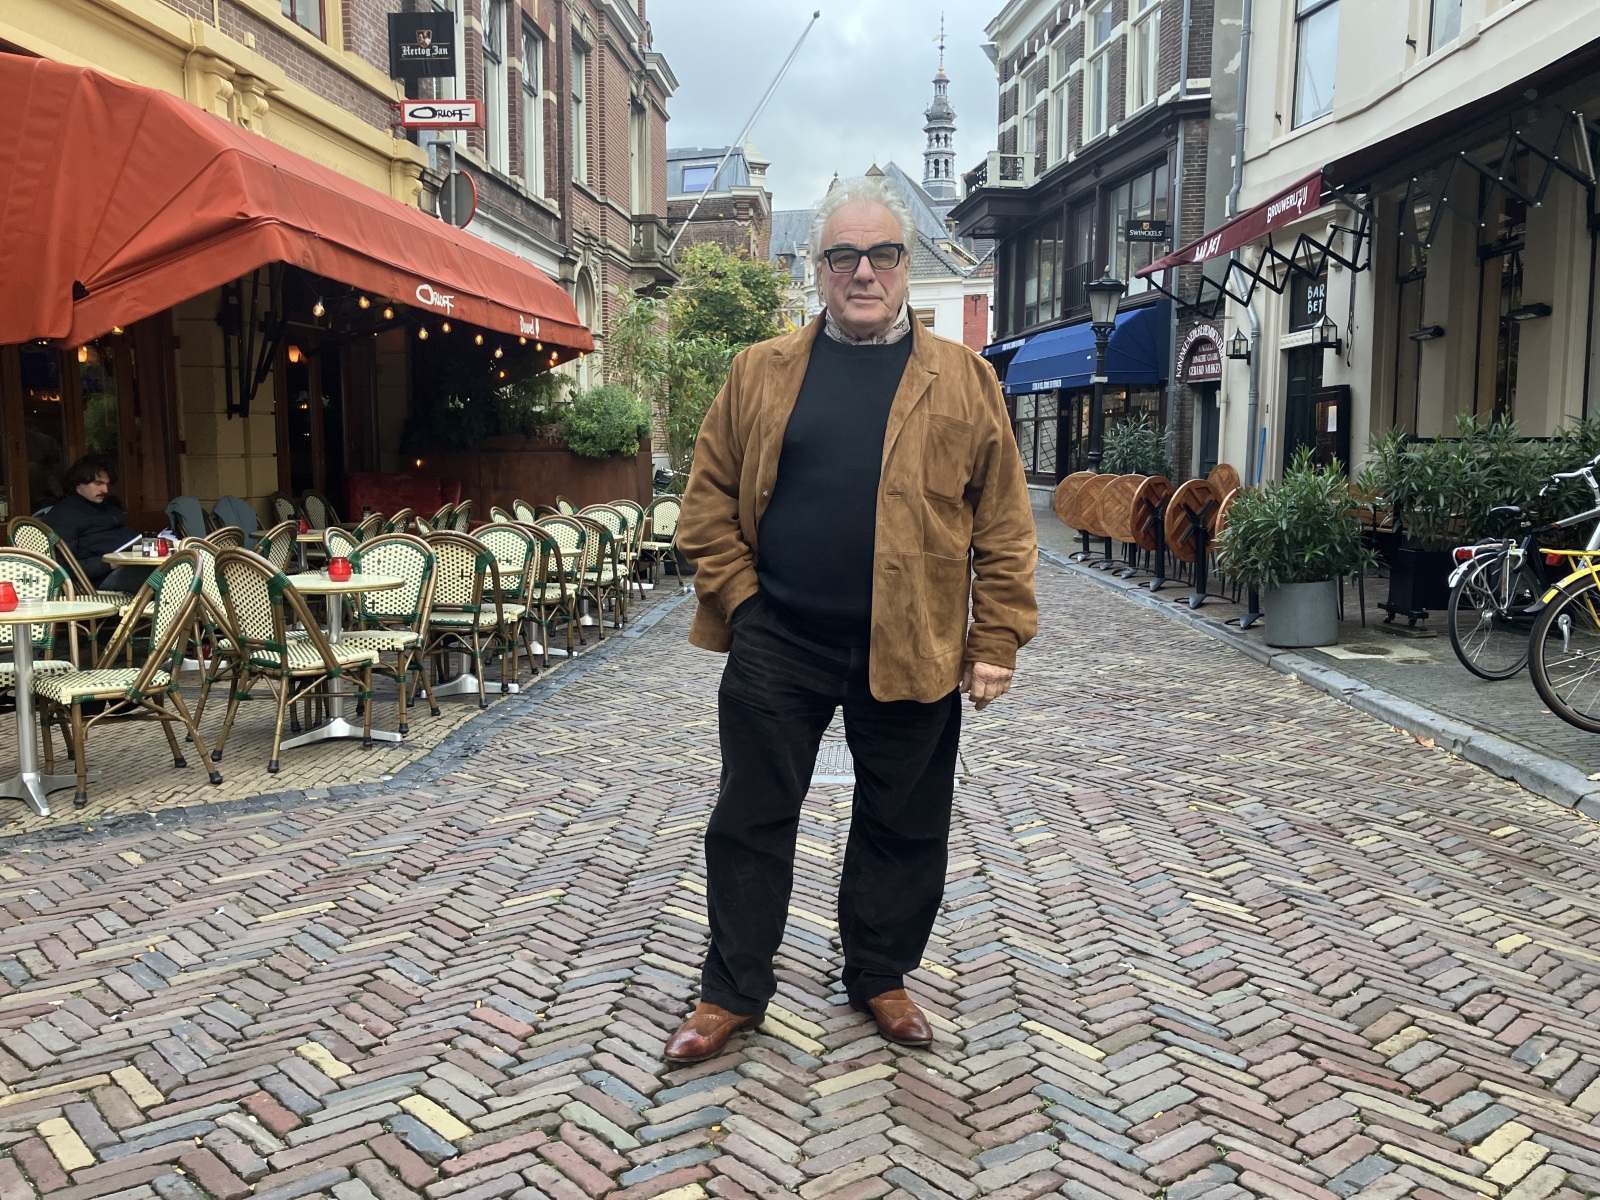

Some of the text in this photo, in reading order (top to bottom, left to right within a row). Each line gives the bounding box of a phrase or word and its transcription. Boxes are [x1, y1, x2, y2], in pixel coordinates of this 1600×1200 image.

[401, 45, 448, 58] Hertog Jan
[1307, 283, 1325, 300] BAR
[1307, 299, 1324, 315] BET
